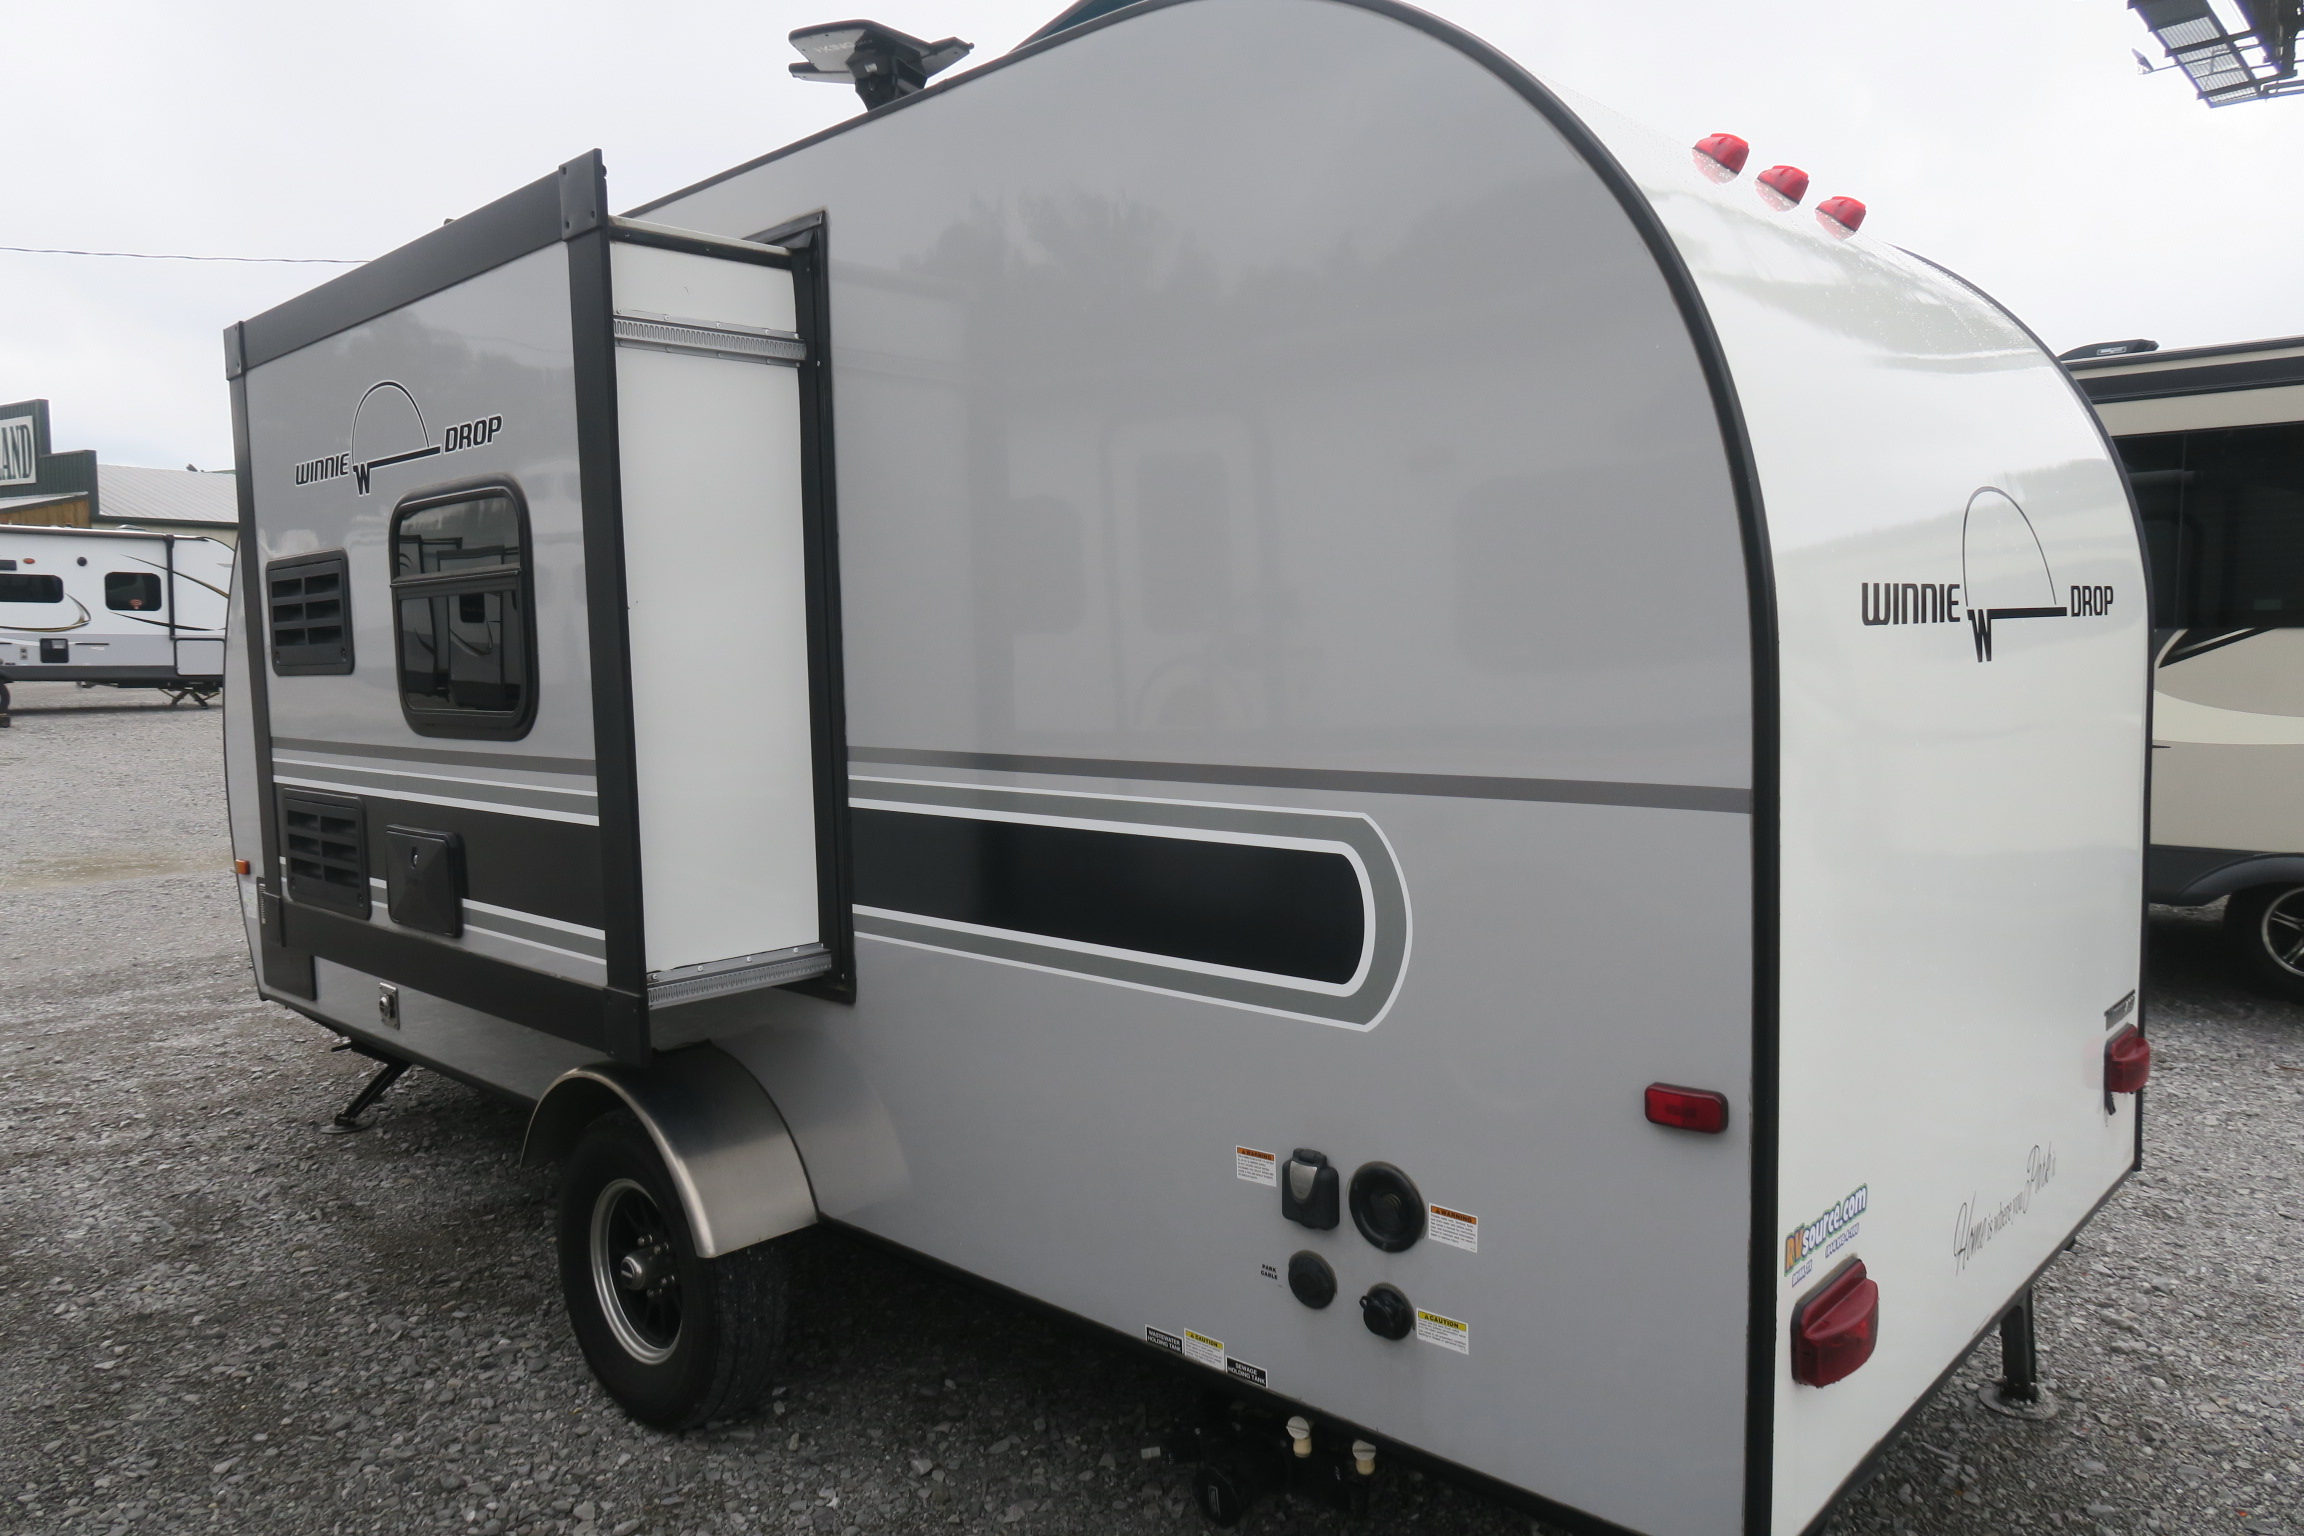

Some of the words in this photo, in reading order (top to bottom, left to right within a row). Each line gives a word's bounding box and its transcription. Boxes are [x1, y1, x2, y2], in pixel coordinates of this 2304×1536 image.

[0, 424, 33, 480] AND
[295, 453, 350, 486] WINNIE
[444, 414, 503, 454] DROP
[1861, 582, 1961, 626] WINNIE
[2070, 585, 2114, 617] DROP
[1246, 1149, 1272, 1161] WARNING
[1440, 1208, 1472, 1223] WARNING
[1784, 1184, 1867, 1275] RVsource.com
[1954, 1190, 1987, 1276] Home
[1261, 1270, 1278, 1280] CABLE
[1262, 1264, 1277, 1273] PARK
[1429, 1314, 1459, 1329] CAUTION
[1195, 1333, 1218, 1348] CAUTION
[1228, 1366, 1251, 1379] HOLDING
[1251, 1374, 1266, 1385] TANK
[1235, 1362, 1258, 1376] SEWAGE
